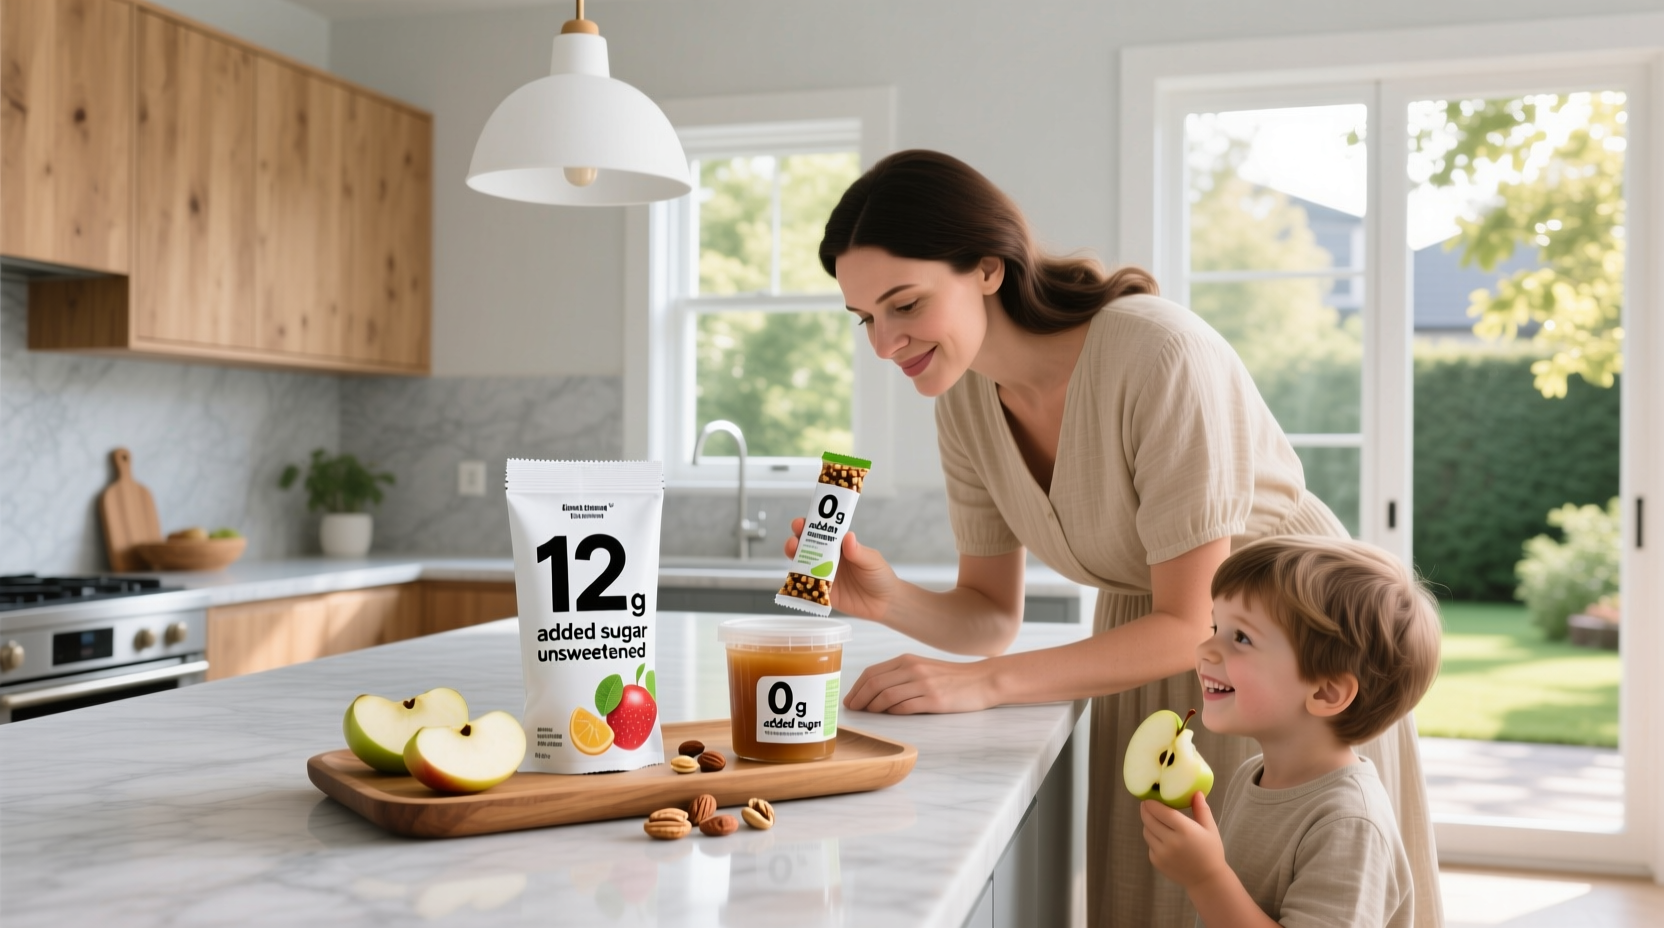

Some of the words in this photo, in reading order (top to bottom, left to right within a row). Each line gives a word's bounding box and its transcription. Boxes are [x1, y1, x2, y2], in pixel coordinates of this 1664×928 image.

[537, 622, 596, 642] added
[600, 625, 648, 643] sugar
[537, 642, 646, 662] unsweetened
